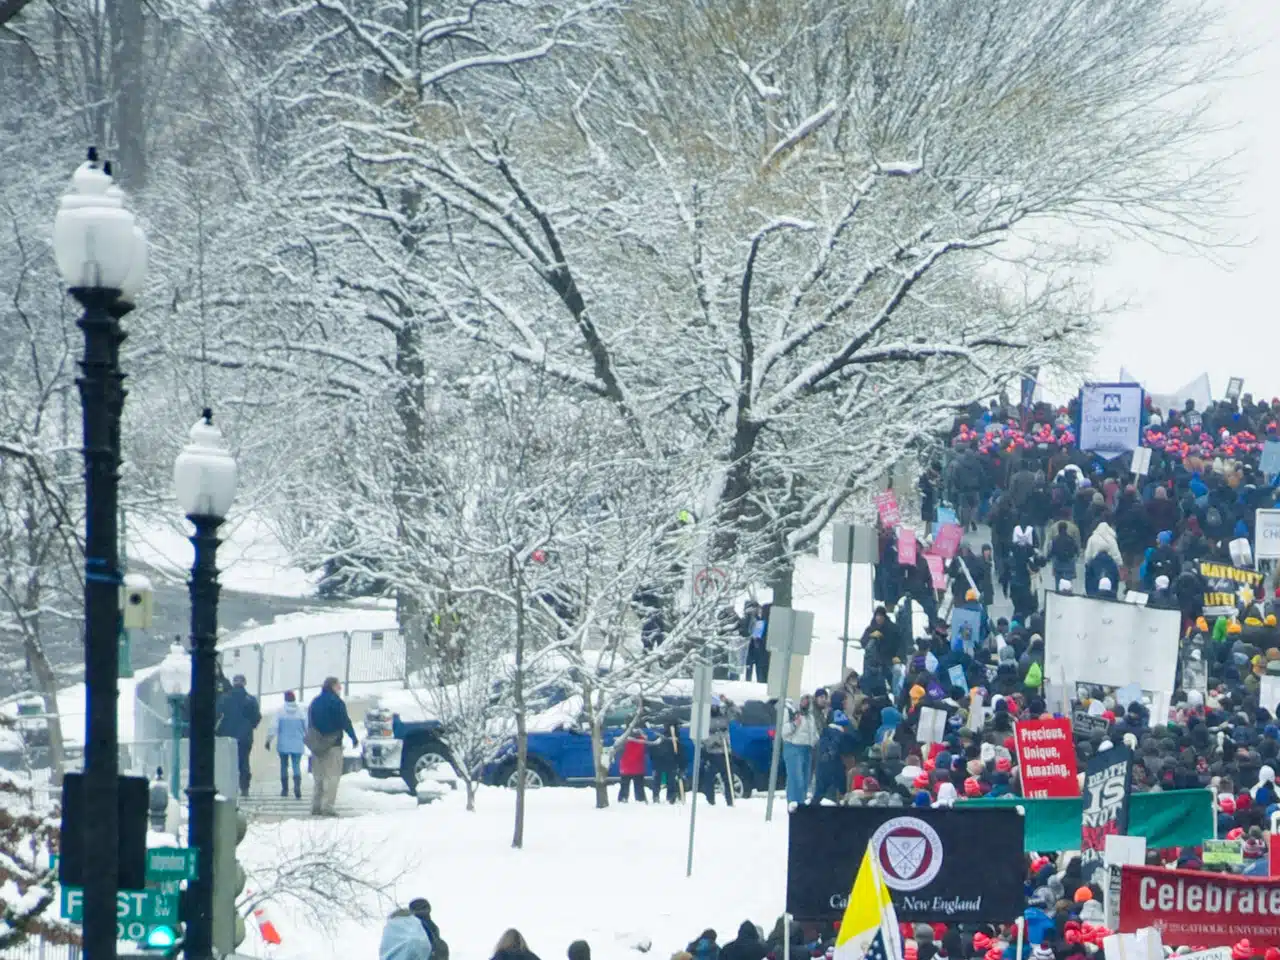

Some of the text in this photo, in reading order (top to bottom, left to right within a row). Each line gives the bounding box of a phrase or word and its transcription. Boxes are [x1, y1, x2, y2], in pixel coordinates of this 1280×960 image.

[1088, 761, 1127, 787] DEATH
[1084, 776, 1125, 813] IS
[1082, 801, 1122, 828] NOT
[66, 889, 148, 918] FST
[903, 896, 981, 913] New England
[1181, 922, 1227, 934] CATHOLIC
